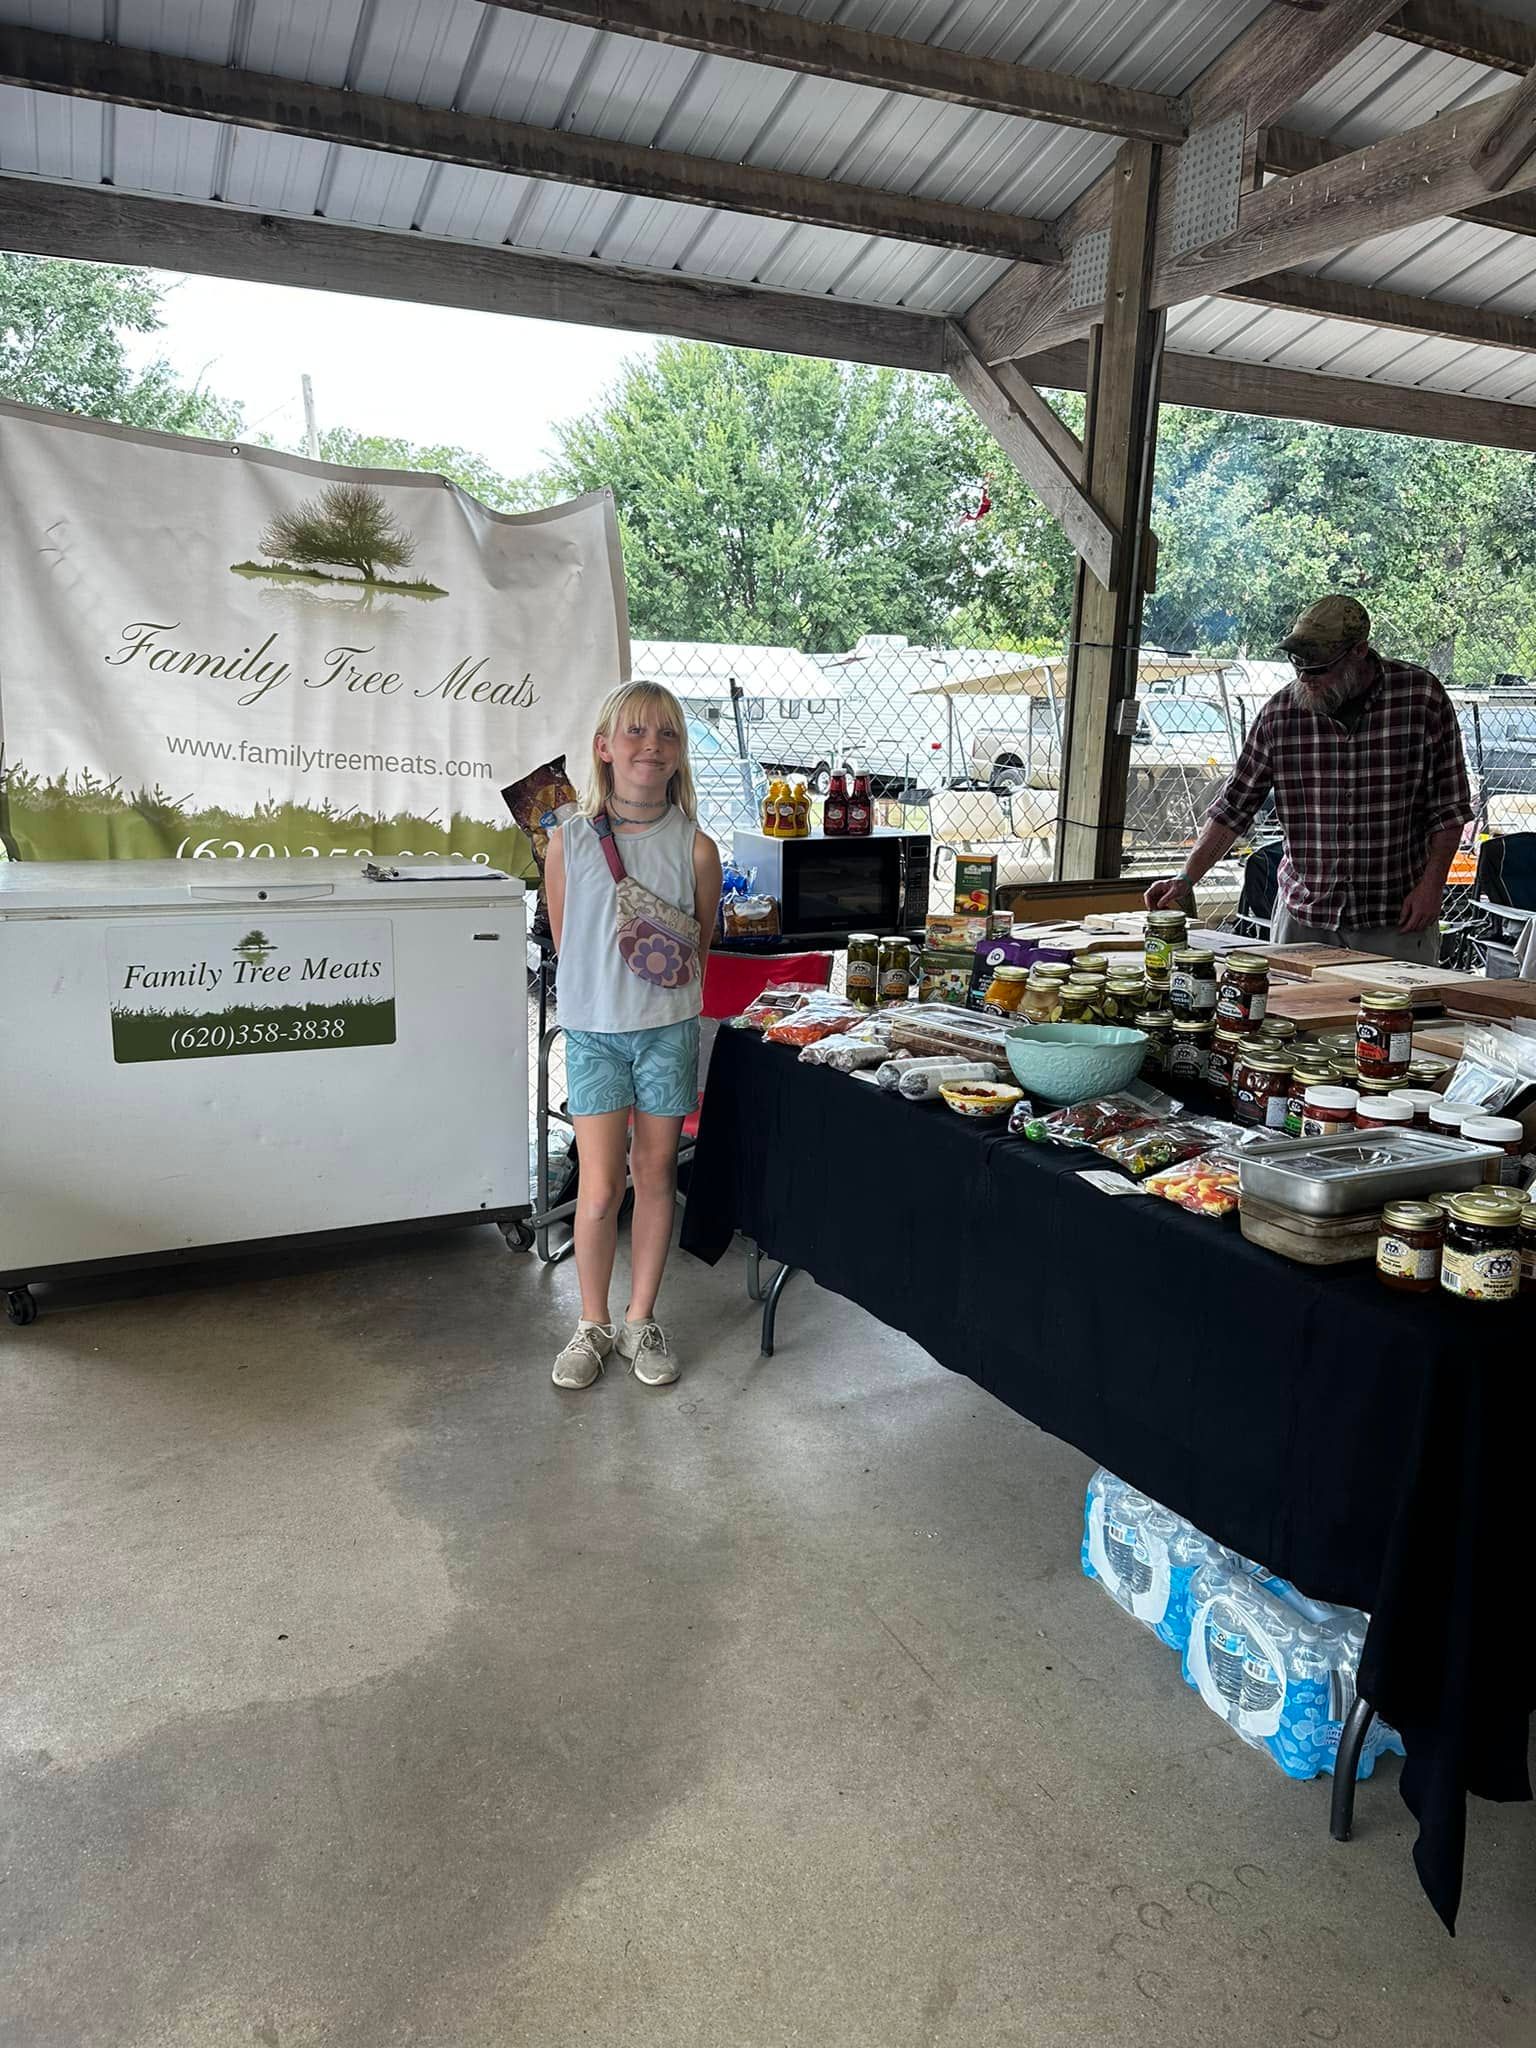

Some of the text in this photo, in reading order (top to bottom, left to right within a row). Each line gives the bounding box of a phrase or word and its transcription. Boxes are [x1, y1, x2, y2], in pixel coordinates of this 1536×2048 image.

[104, 622, 541, 708] Family Tree Meats
[166, 734, 493, 779] www.familytreemeats.com
[123, 957, 382, 991] Family Tree Meats
[170, 1018, 346, 1053] (620)358-3838
